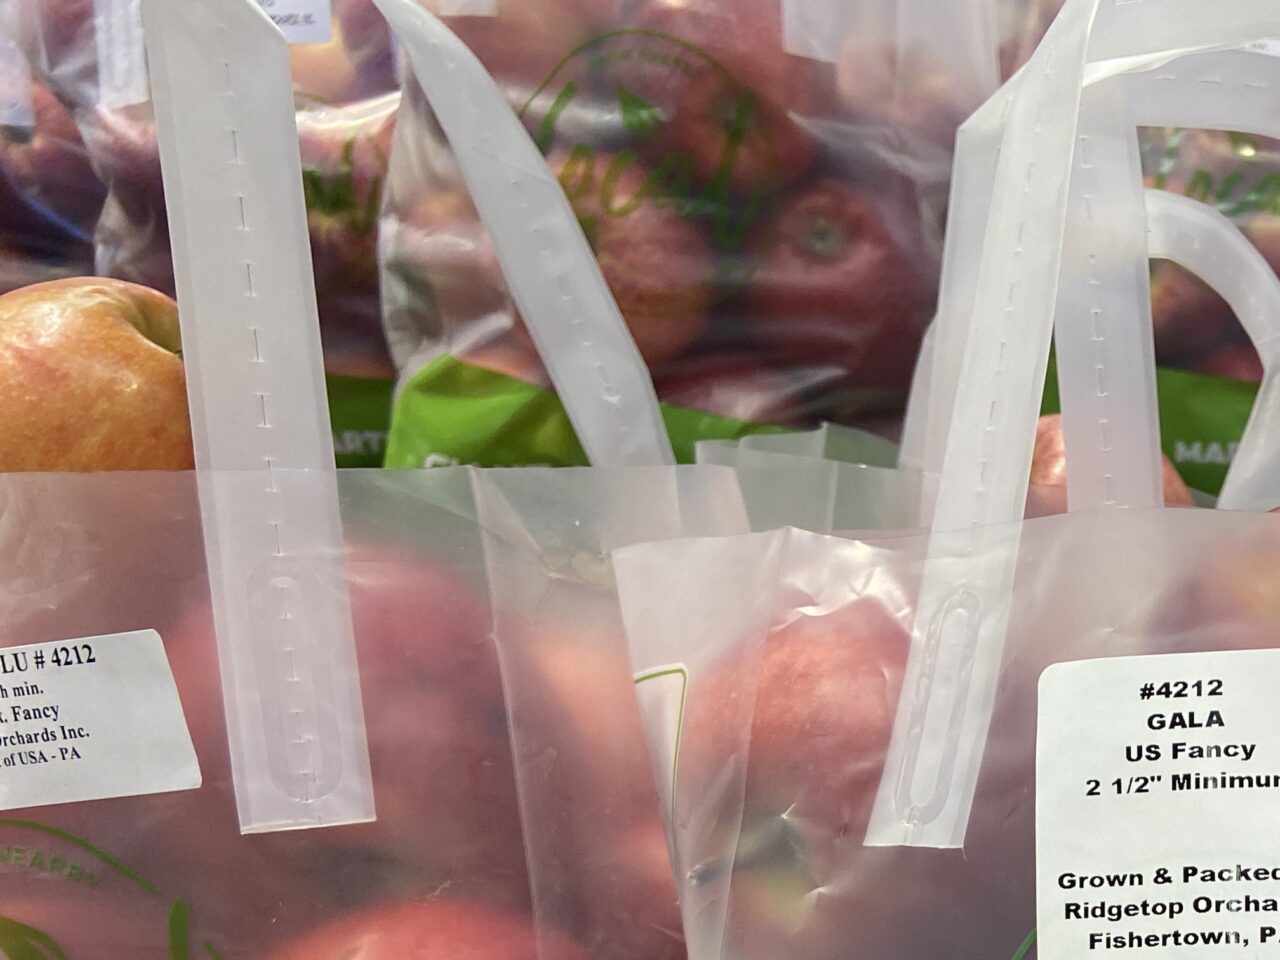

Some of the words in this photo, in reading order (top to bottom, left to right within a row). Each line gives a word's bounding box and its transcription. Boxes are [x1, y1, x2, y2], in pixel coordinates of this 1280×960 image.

[0, 651, 29, 673] LU
[34, 649, 46, 670] #
[51, 644, 96, 668] 4212
[13, 682, 44, 698] min.
[1139, 679, 1224, 700] #4212
[11, 704, 59, 723] Fancy
[1147, 710, 1225, 730] GALA
[60, 725, 90, 740] Inc.
[4, 754, 16, 767] of
[18, 751, 48, 766] USA
[60, 747, 81, 761] PA
[1125, 744, 1162, 762] US
[1172, 742, 1256, 762] Fancy
[1085, 779, 1101, 797] 2
[1111, 775, 1162, 795] 1/2"
[1058, 872, 1144, 889] Grown
[1153, 867, 1173, 885] &
[1064, 898, 1184, 921] Ridgetop
[1089, 929, 1249, 950] Fishertown,
